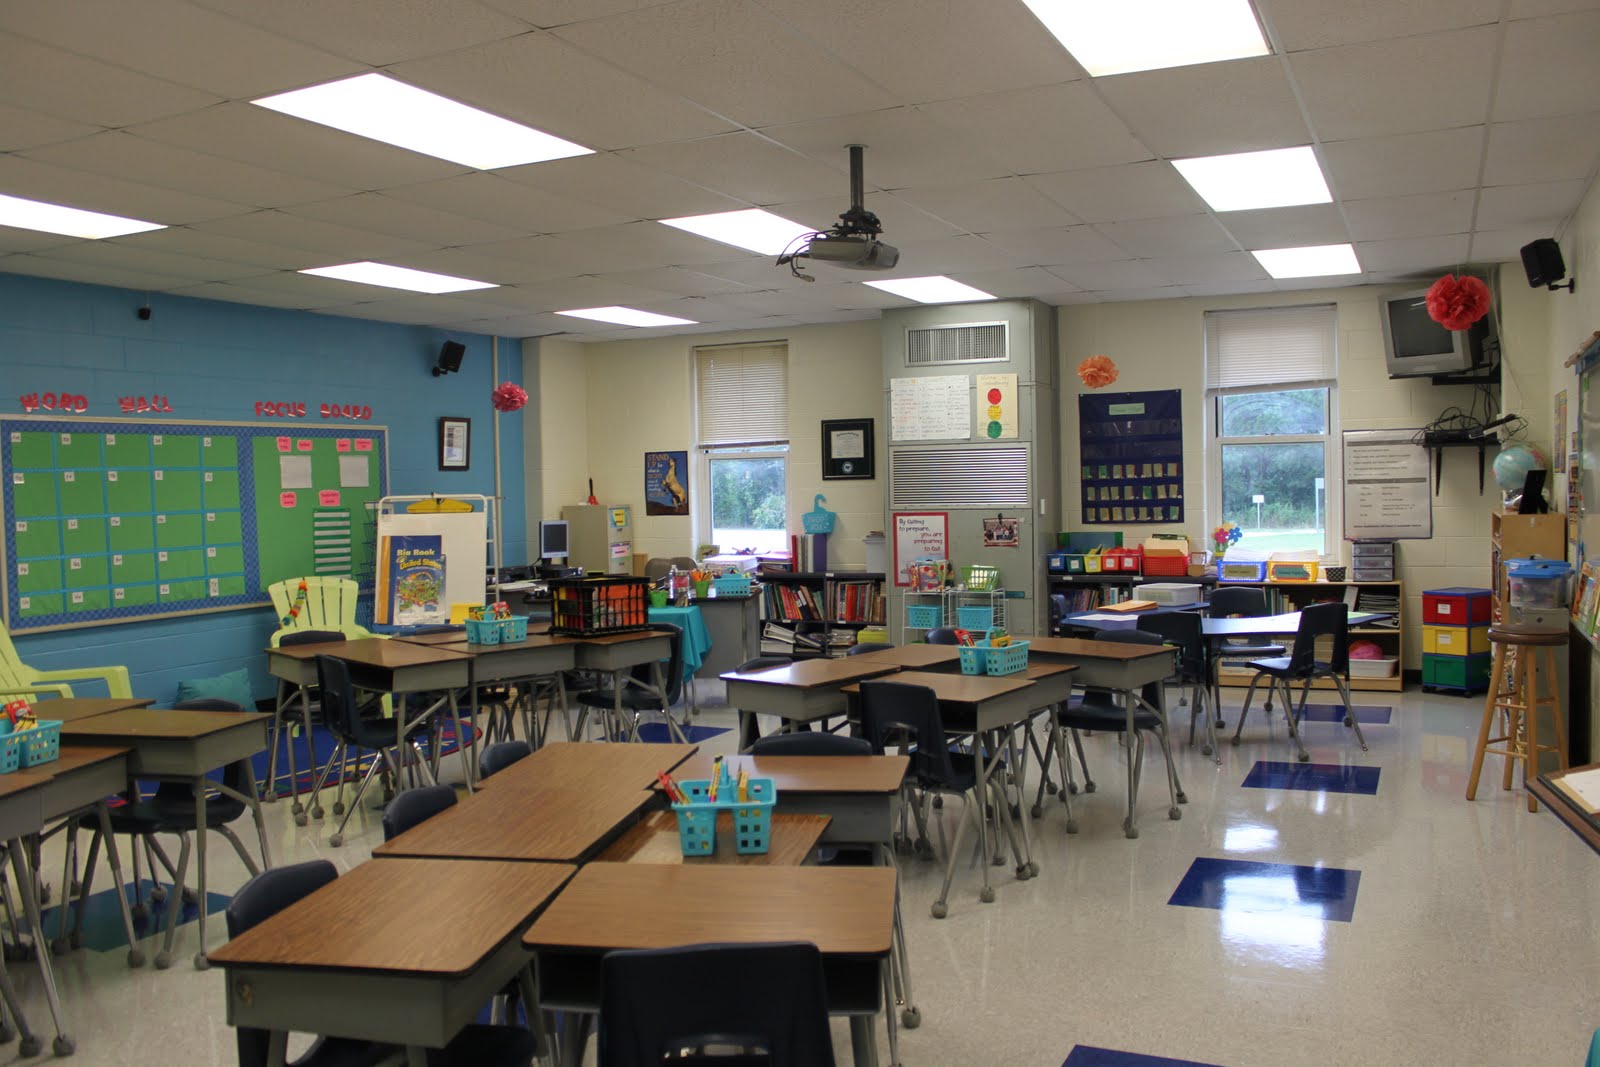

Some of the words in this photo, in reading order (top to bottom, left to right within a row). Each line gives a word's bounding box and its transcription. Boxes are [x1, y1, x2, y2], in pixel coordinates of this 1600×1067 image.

[20, 392, 88, 414] WORD
[118, 395, 174, 414] WALL
[254, 401, 306, 418] FOCUS
[320, 404, 372, 420] BOARD
[422, 558, 442, 570] States
